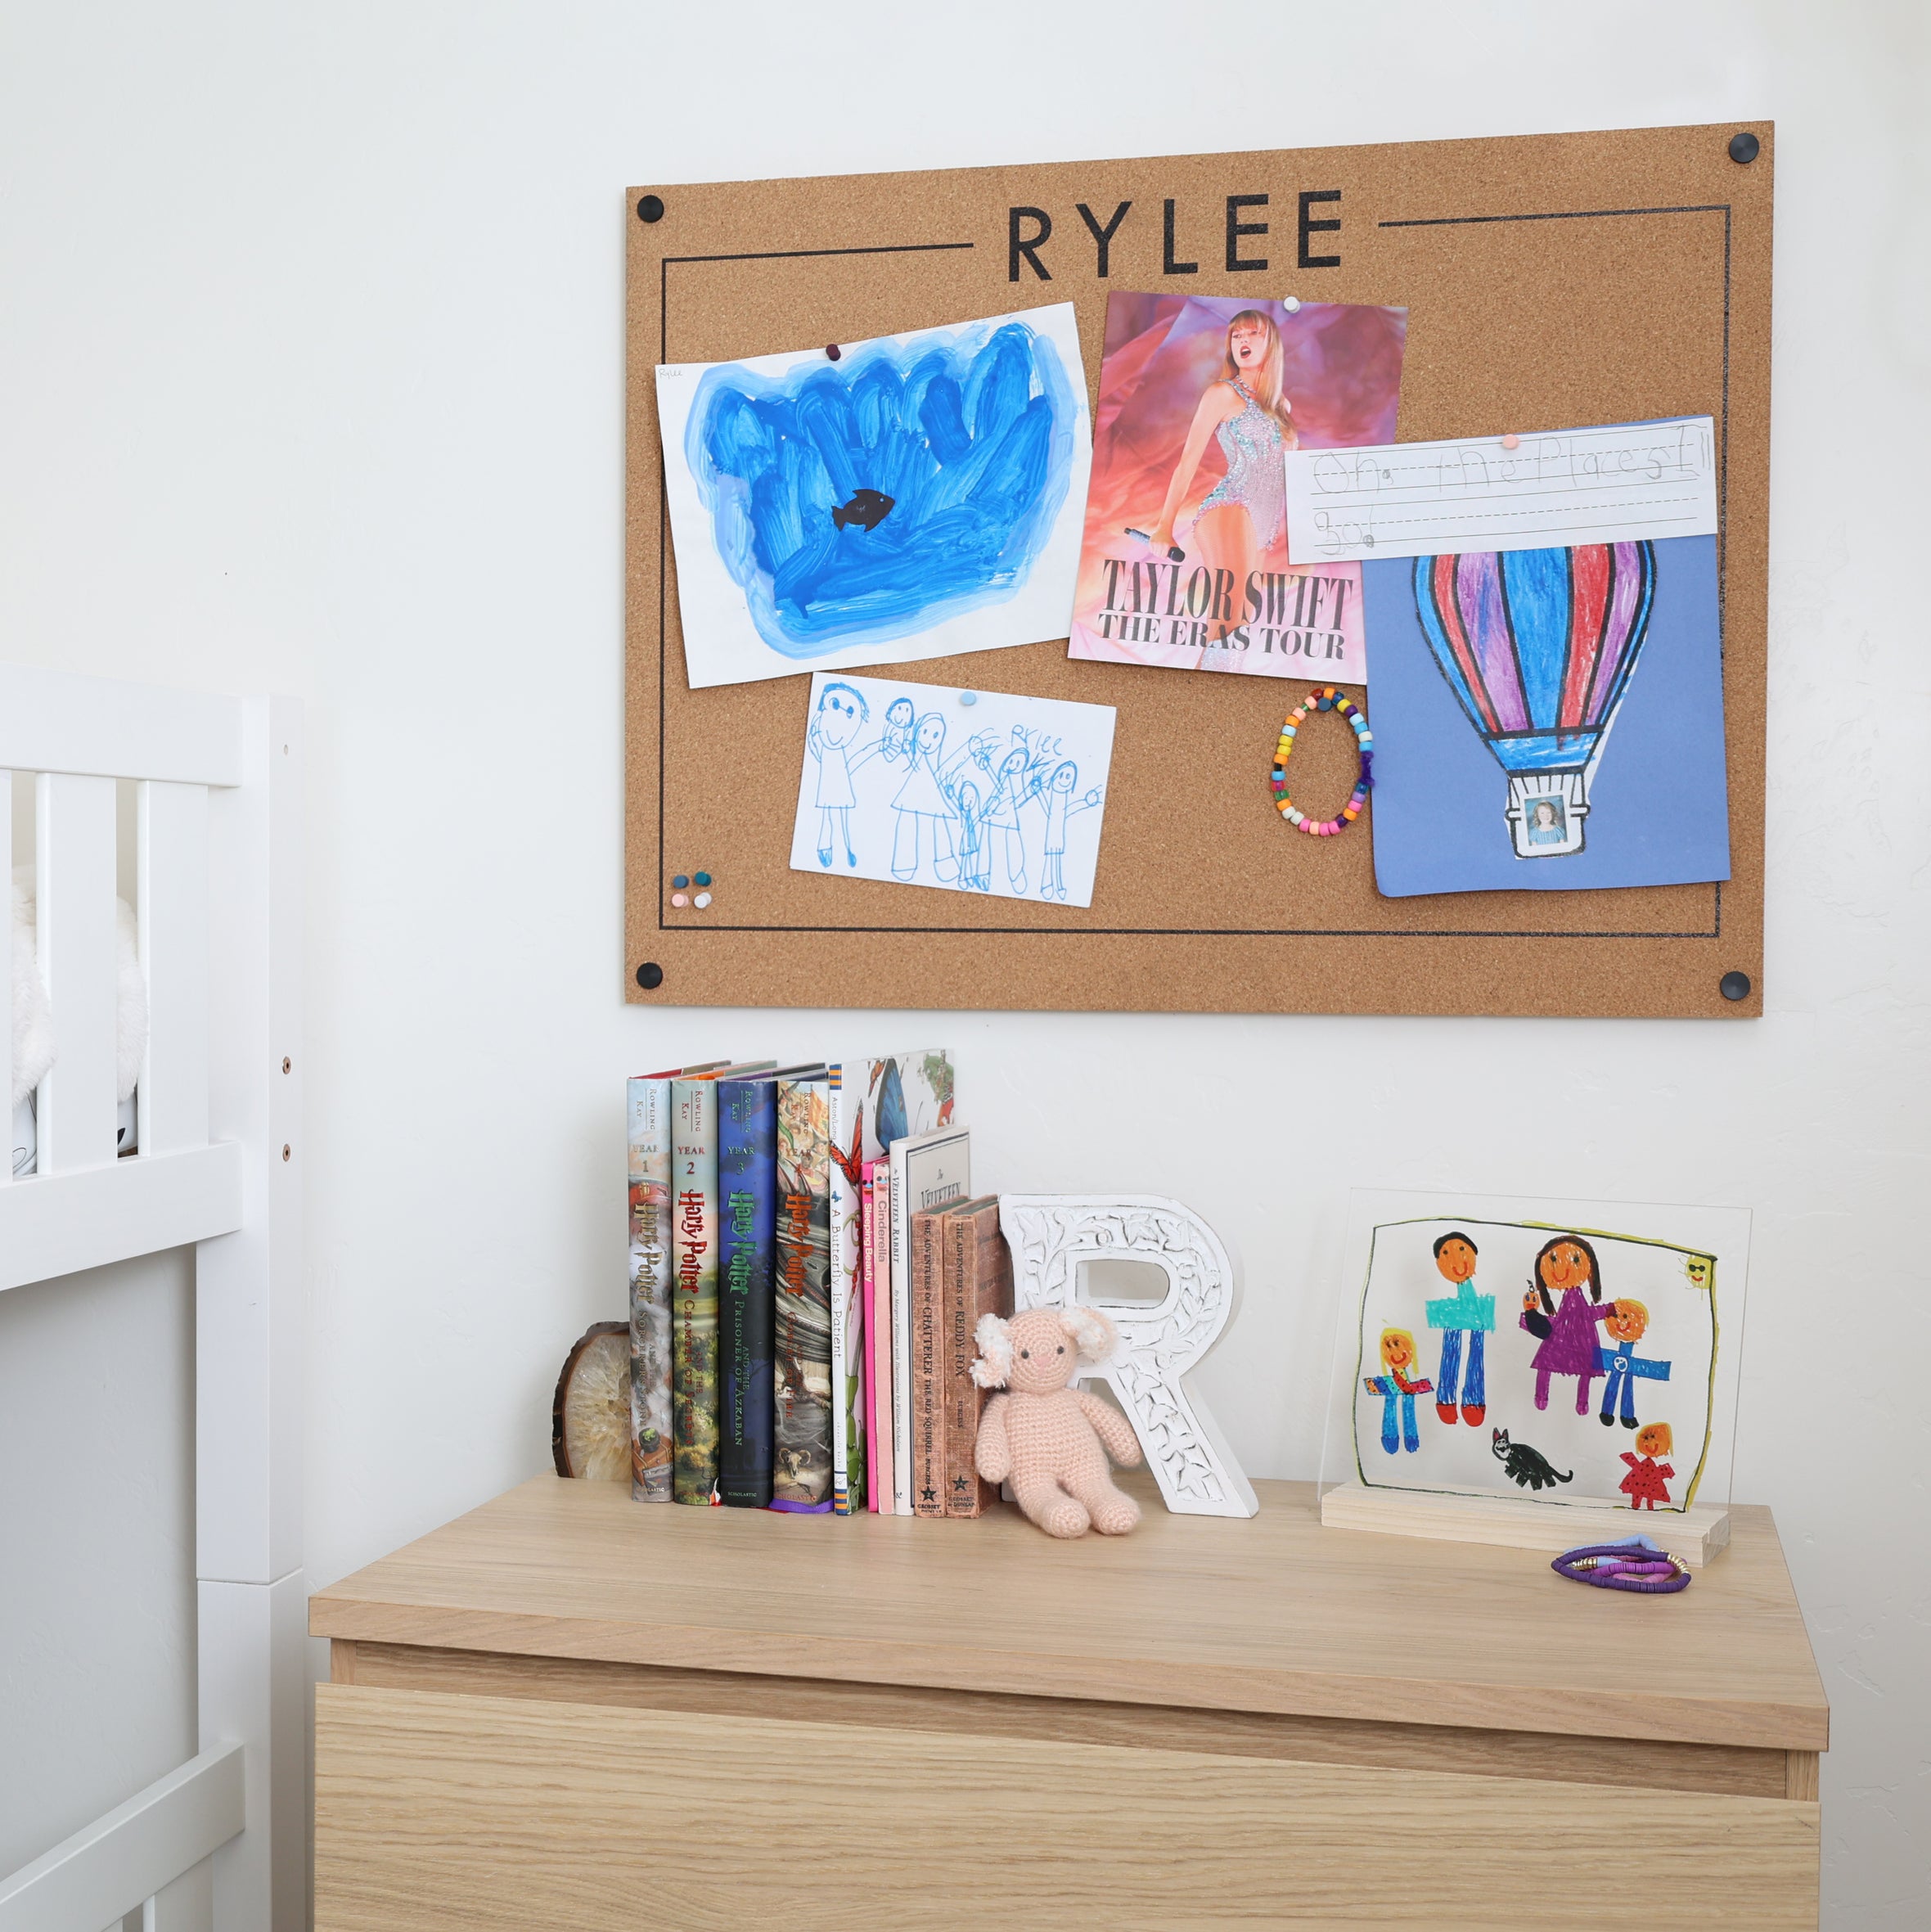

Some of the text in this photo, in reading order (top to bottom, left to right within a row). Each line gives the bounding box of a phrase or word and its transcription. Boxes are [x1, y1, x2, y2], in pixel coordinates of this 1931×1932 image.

[1009, 190, 1341, 282] RYLEE
[1430, 446, 1524, 493] the
[1101, 559, 1353, 631] TAYLOR SWIFT
[1097, 614, 1345, 660] THE ERAS TOUR
[695, 1090, 704, 1132] ROWLING
[731, 1103, 740, 1120] KAY
[745, 1090, 753, 1133] ROWLING
[803, 1092, 811, 1135] ROWLING
[632, 1144, 660, 1153] YEAR
[642, 1160, 649, 1173] 1
[678, 1146, 705, 1155] YEAR
[686, 1162, 695, 1174] 2
[727, 1146, 755, 1155] YEAR
[737, 1162, 745, 1175] 3
[785, 1148, 811, 1157] YEAR
[634, 1200, 664, 1304] Harry Potter
[678, 1189, 707, 1295] Harry Potter
[727, 1189, 757, 1295] Harry Potter
[782, 1191, 815, 1297] Harry Potter
[864, 1203, 873, 1283] Sleeping Beauty
[878, 1200, 887, 1263] Cinderella
[831, 1209, 843, 1359] A Butterfly Is Patient
[924, 1294, 931, 1303] OF
[956, 1296, 963, 1307] OF
[923, 1307, 932, 1375] CHATTERER
[955, 1311, 965, 1349] REDDY
[684, 1299, 695, 1446] CHAMBER OF SECRETS
[735, 1300, 745, 1446] PRISONER OF AZKABAN
[955, 1354, 965, 1377] FOX
[923, 1416, 932, 1455] SQUIRREL
